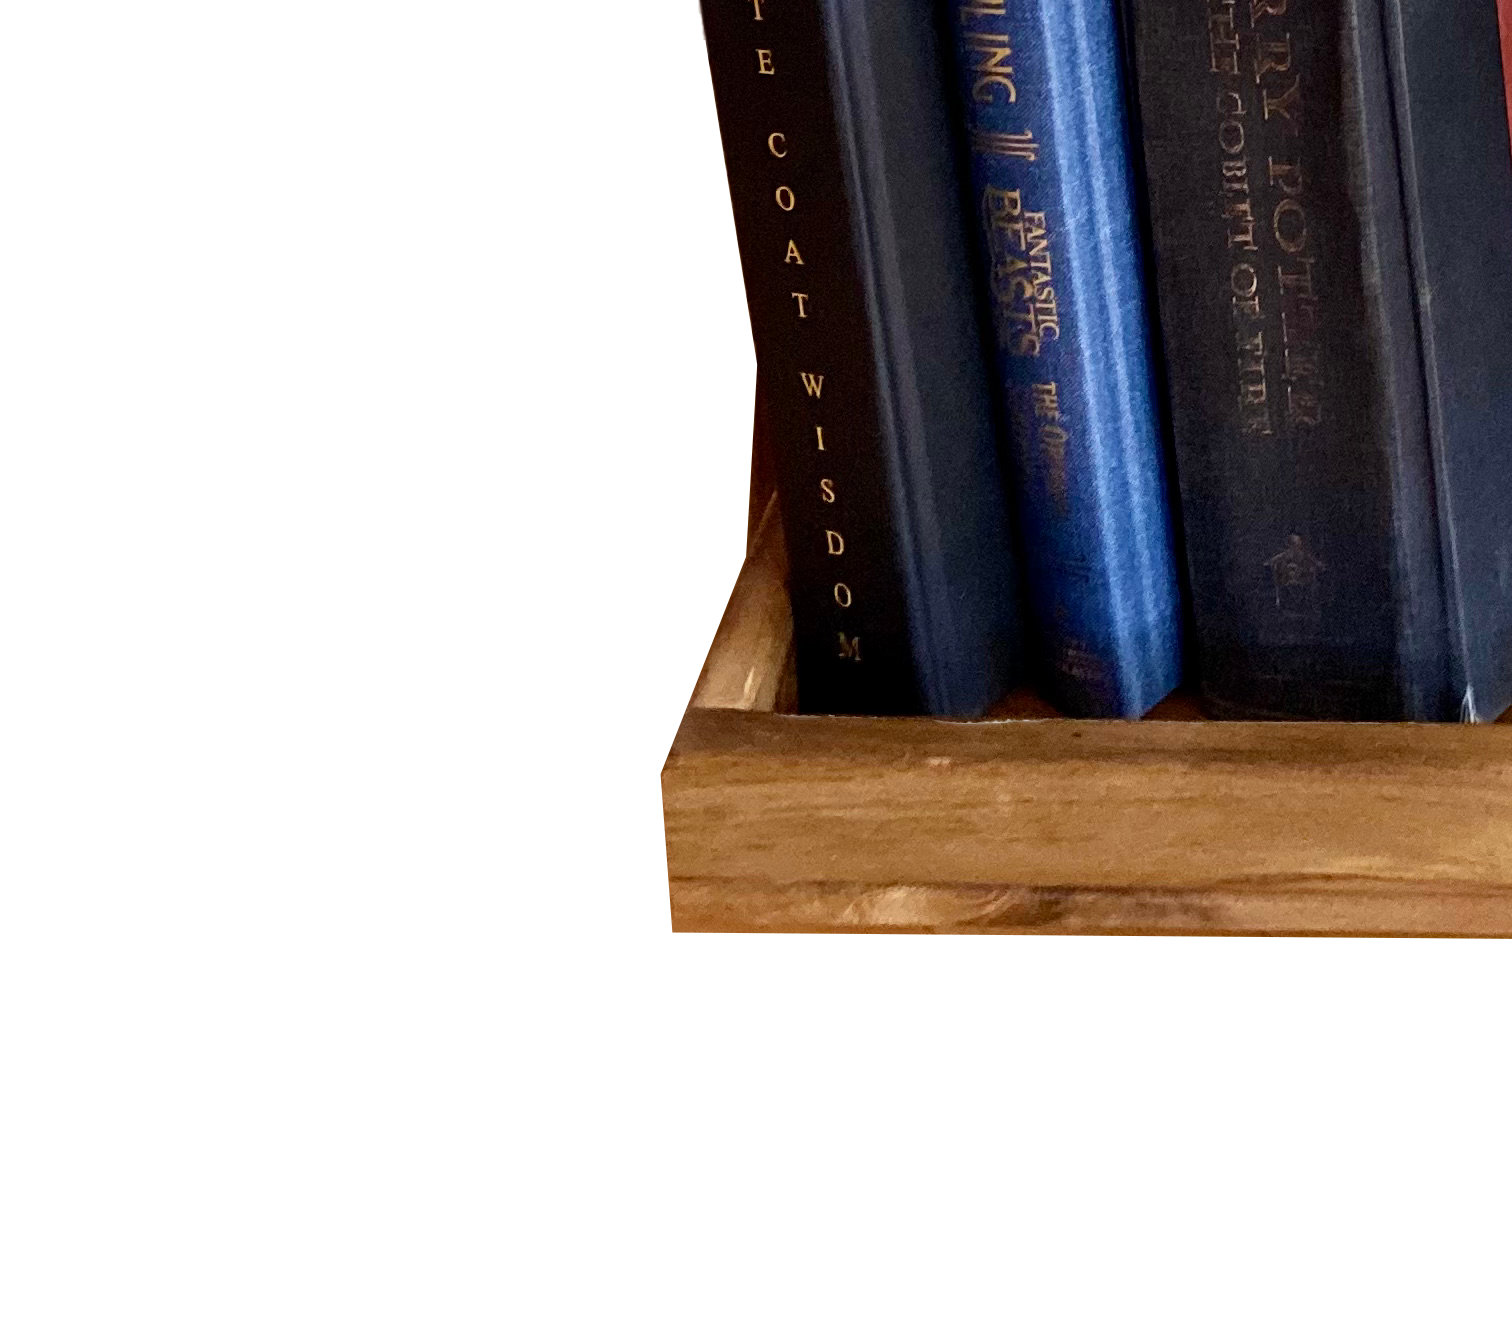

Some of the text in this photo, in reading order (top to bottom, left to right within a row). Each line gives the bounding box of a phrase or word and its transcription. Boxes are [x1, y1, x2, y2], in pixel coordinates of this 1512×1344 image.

[982, 185, 1041, 359] BEASTS
[1023, 209, 1060, 342] FANTASTIC
[768, 132, 809, 319] COAT
[800, 372, 861, 663] WISDOM
[1032, 381, 1059, 420] THE
